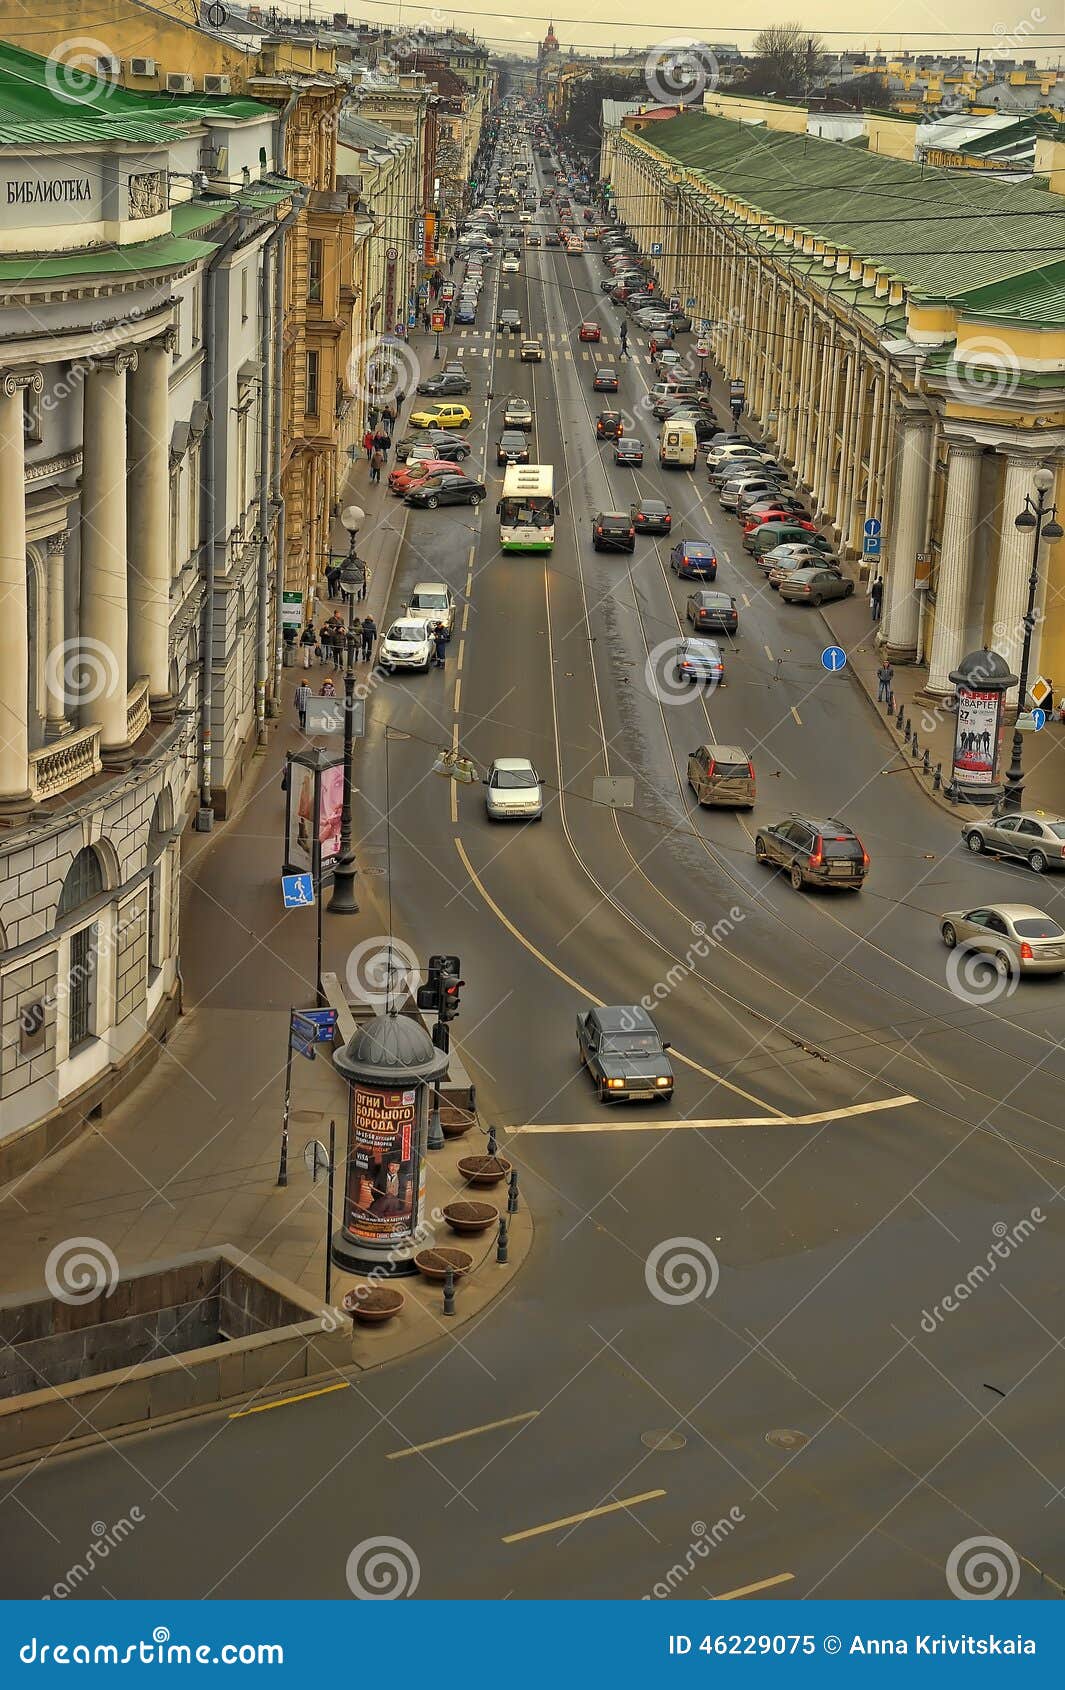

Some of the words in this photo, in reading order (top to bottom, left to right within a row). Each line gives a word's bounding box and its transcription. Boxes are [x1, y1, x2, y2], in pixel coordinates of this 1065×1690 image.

[6, 178, 91, 204] БИБЛИОТЕКА
[867, 539, 878, 552] P
[961, 698, 998, 710] КВАРТЕТ
[960, 709, 969, 719] 27
[356, 1093, 380, 1108] ОГНИ
[356, 1104, 411, 1120] БОЛЬШОГО
[356, 1115, 394, 1131] ГОРОДА
